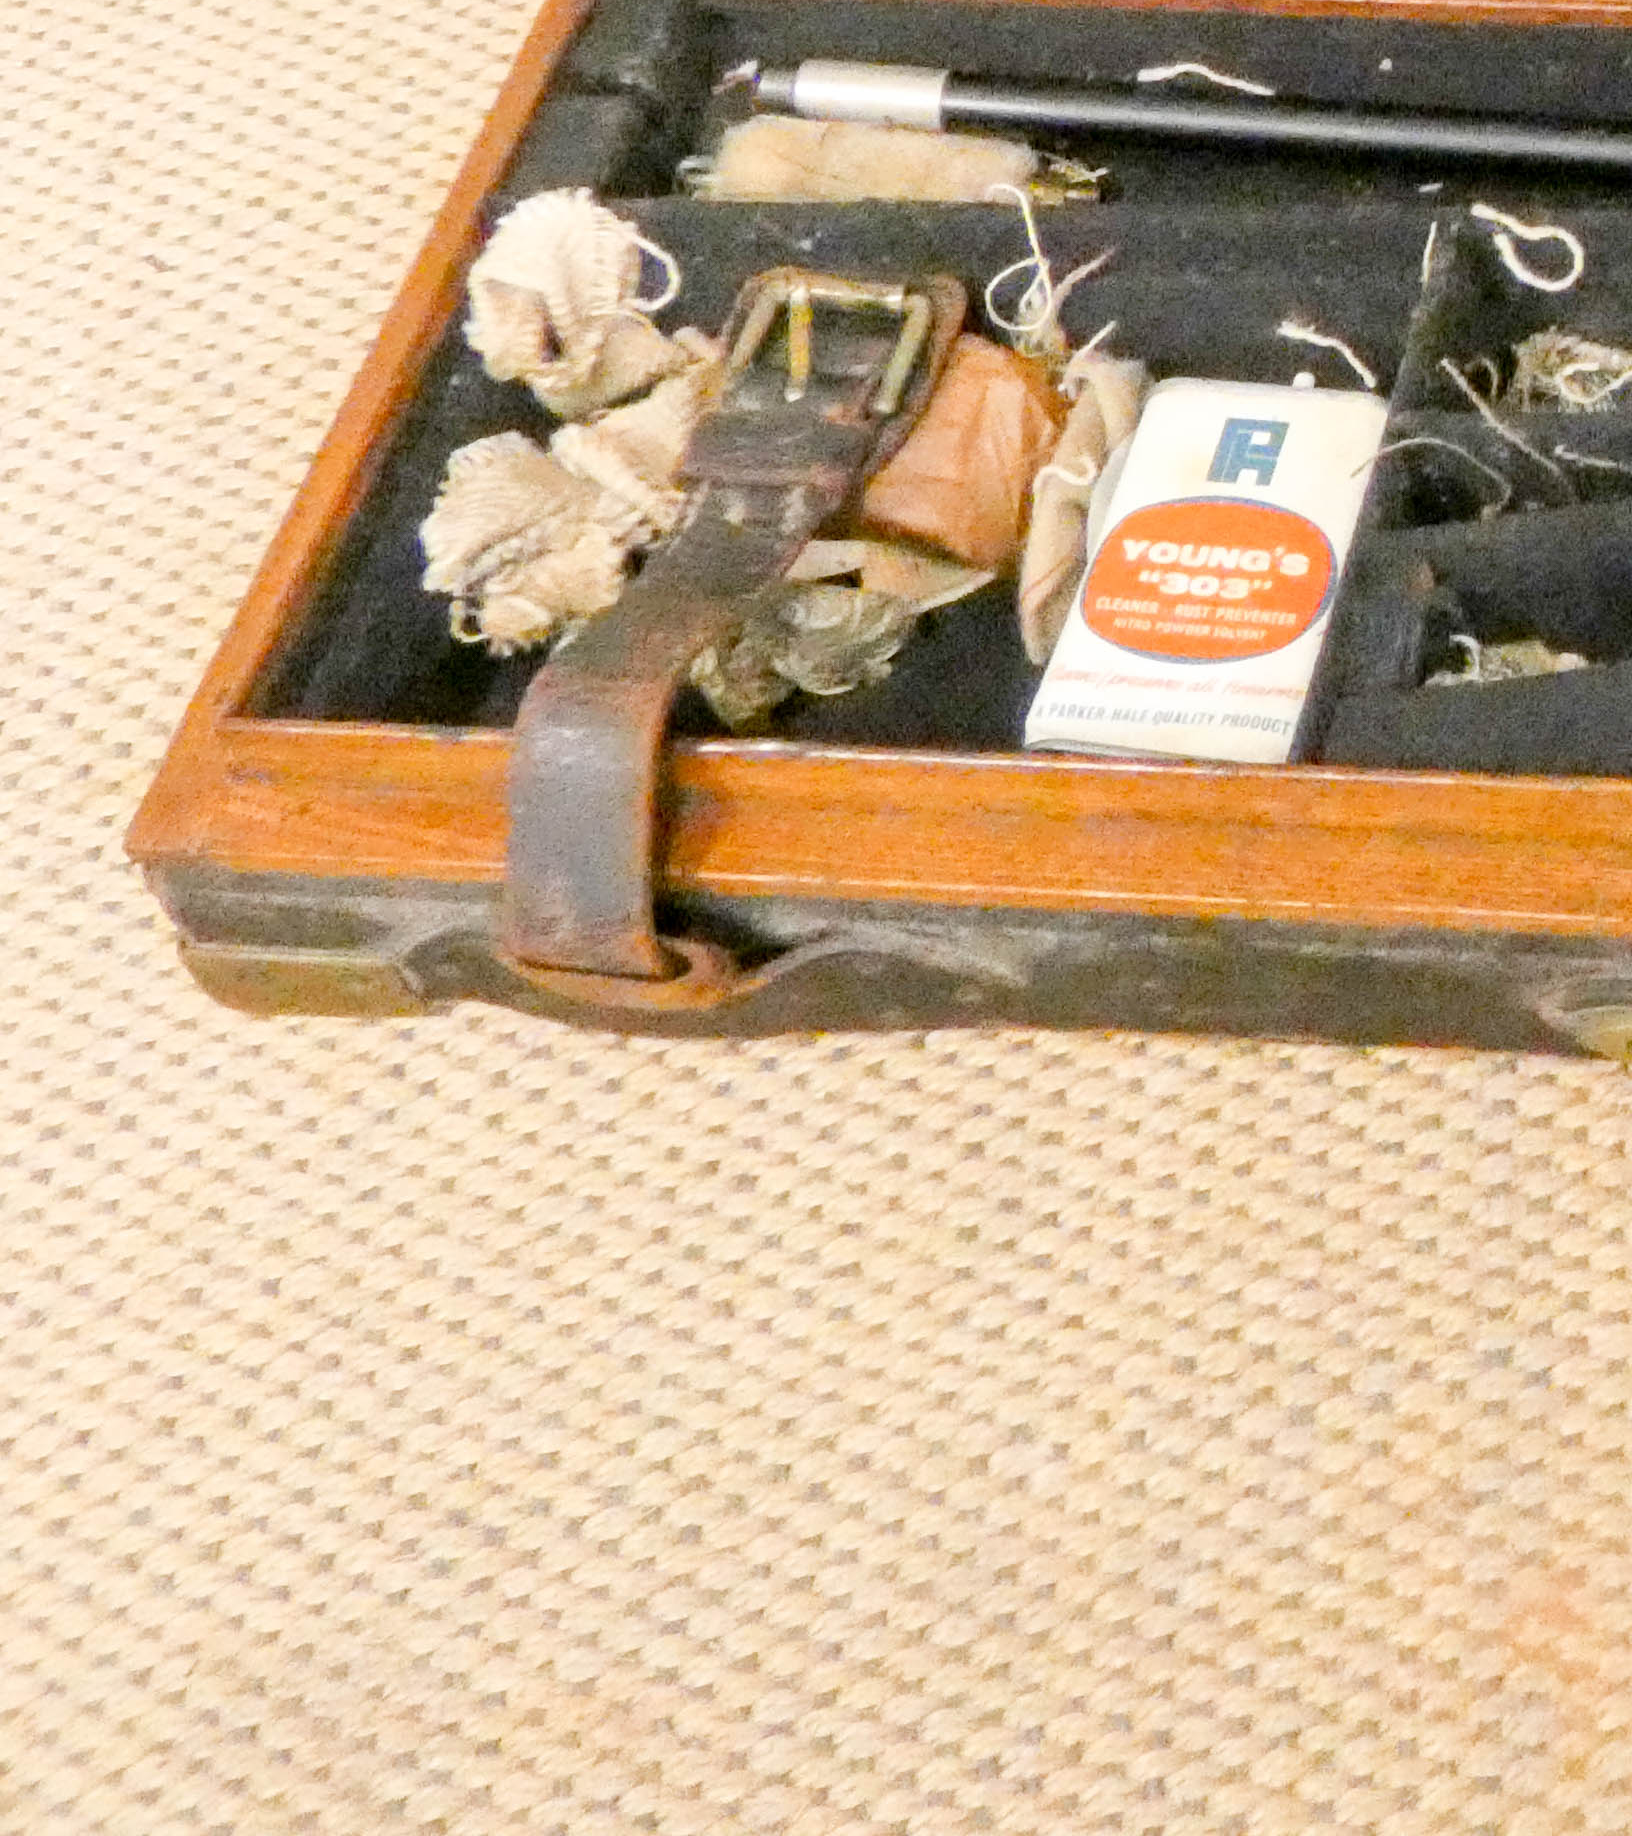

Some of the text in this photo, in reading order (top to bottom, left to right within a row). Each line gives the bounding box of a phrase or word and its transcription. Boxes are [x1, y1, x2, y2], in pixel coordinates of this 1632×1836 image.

[1122, 539, 1311, 576] YOUNG'S
[1095, 596, 1298, 627] CLEANER RUST PREVENTER
[1112, 616, 1268, 641] NITRO POWDER SOLVENT
[1151, 710, 1216, 727] QUALITY
[1219, 713, 1293, 737] PRODUCT
